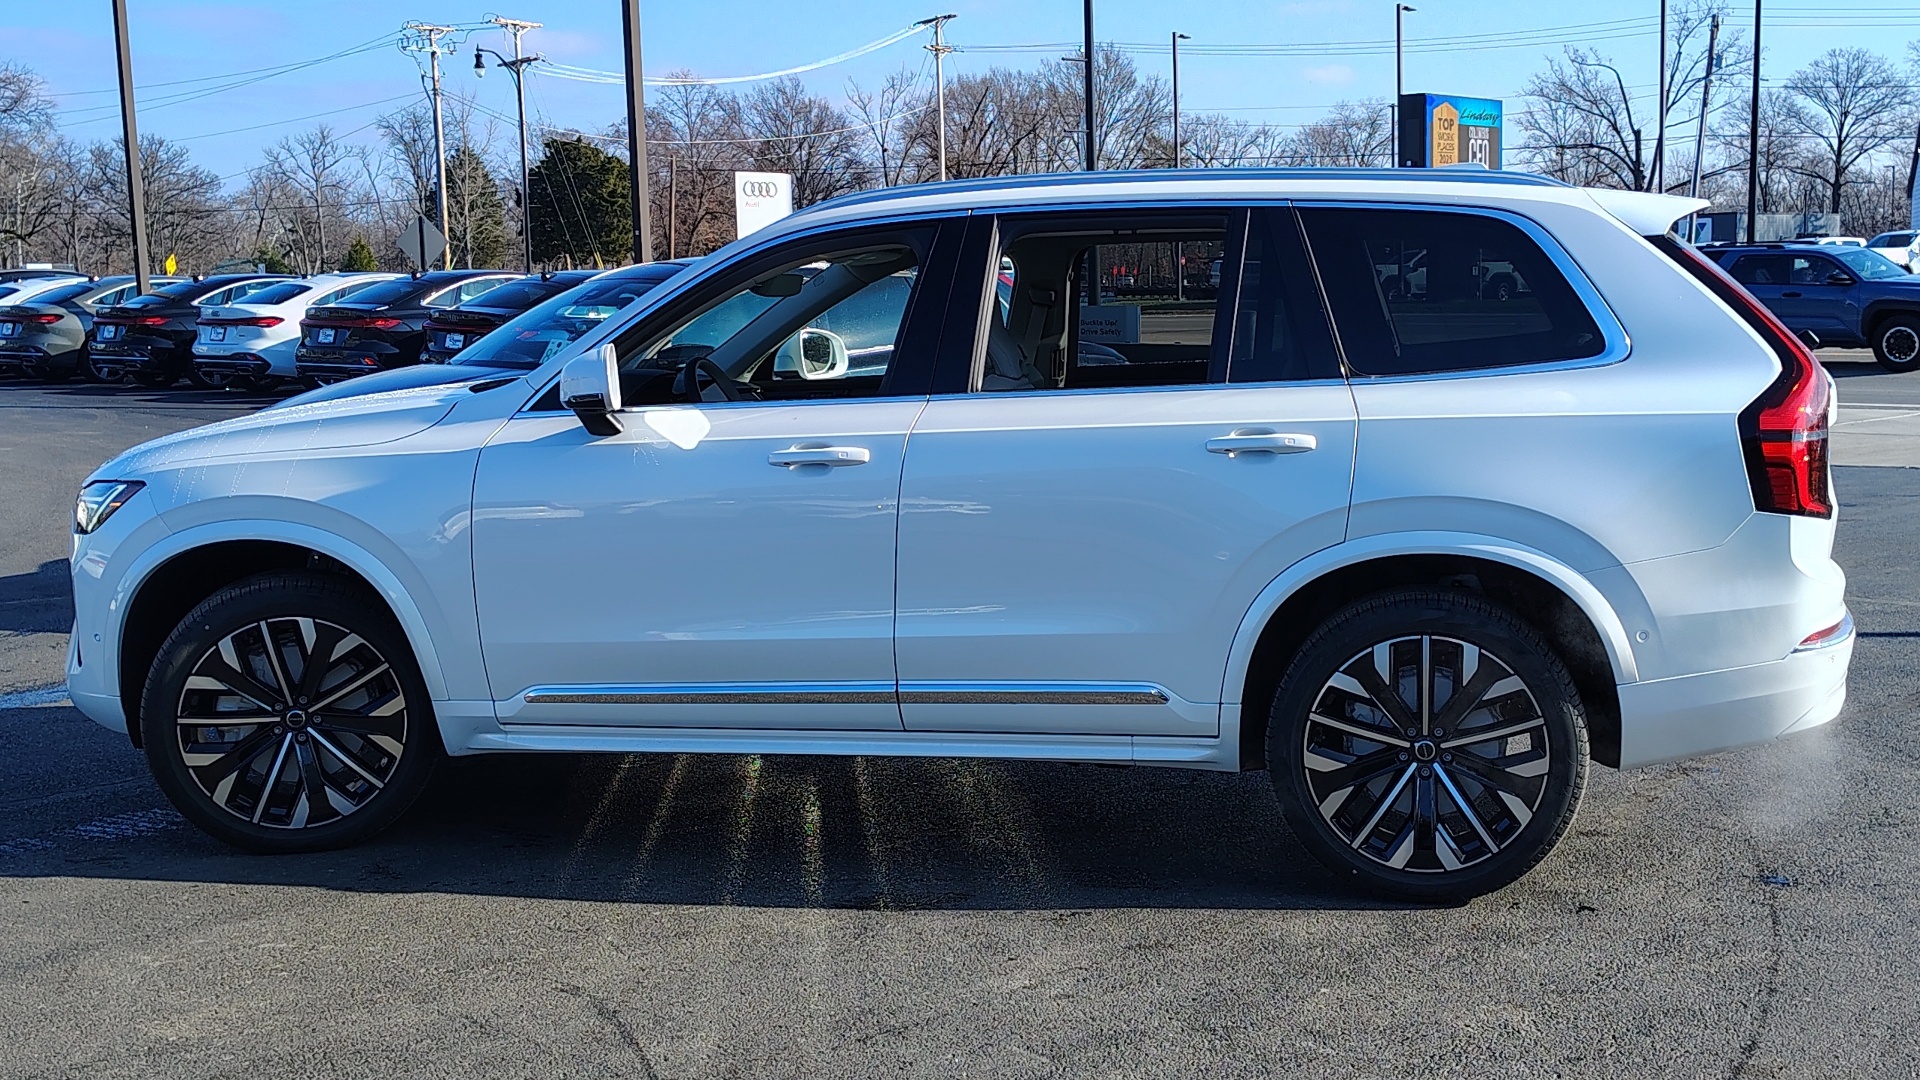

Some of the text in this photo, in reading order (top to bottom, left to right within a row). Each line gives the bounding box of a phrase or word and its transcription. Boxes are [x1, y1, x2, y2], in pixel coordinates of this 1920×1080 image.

[1460, 107, 1501, 125] Lindsay
[1438, 117, 1455, 131] TOP
[1099, 328, 1122, 337] Safely
